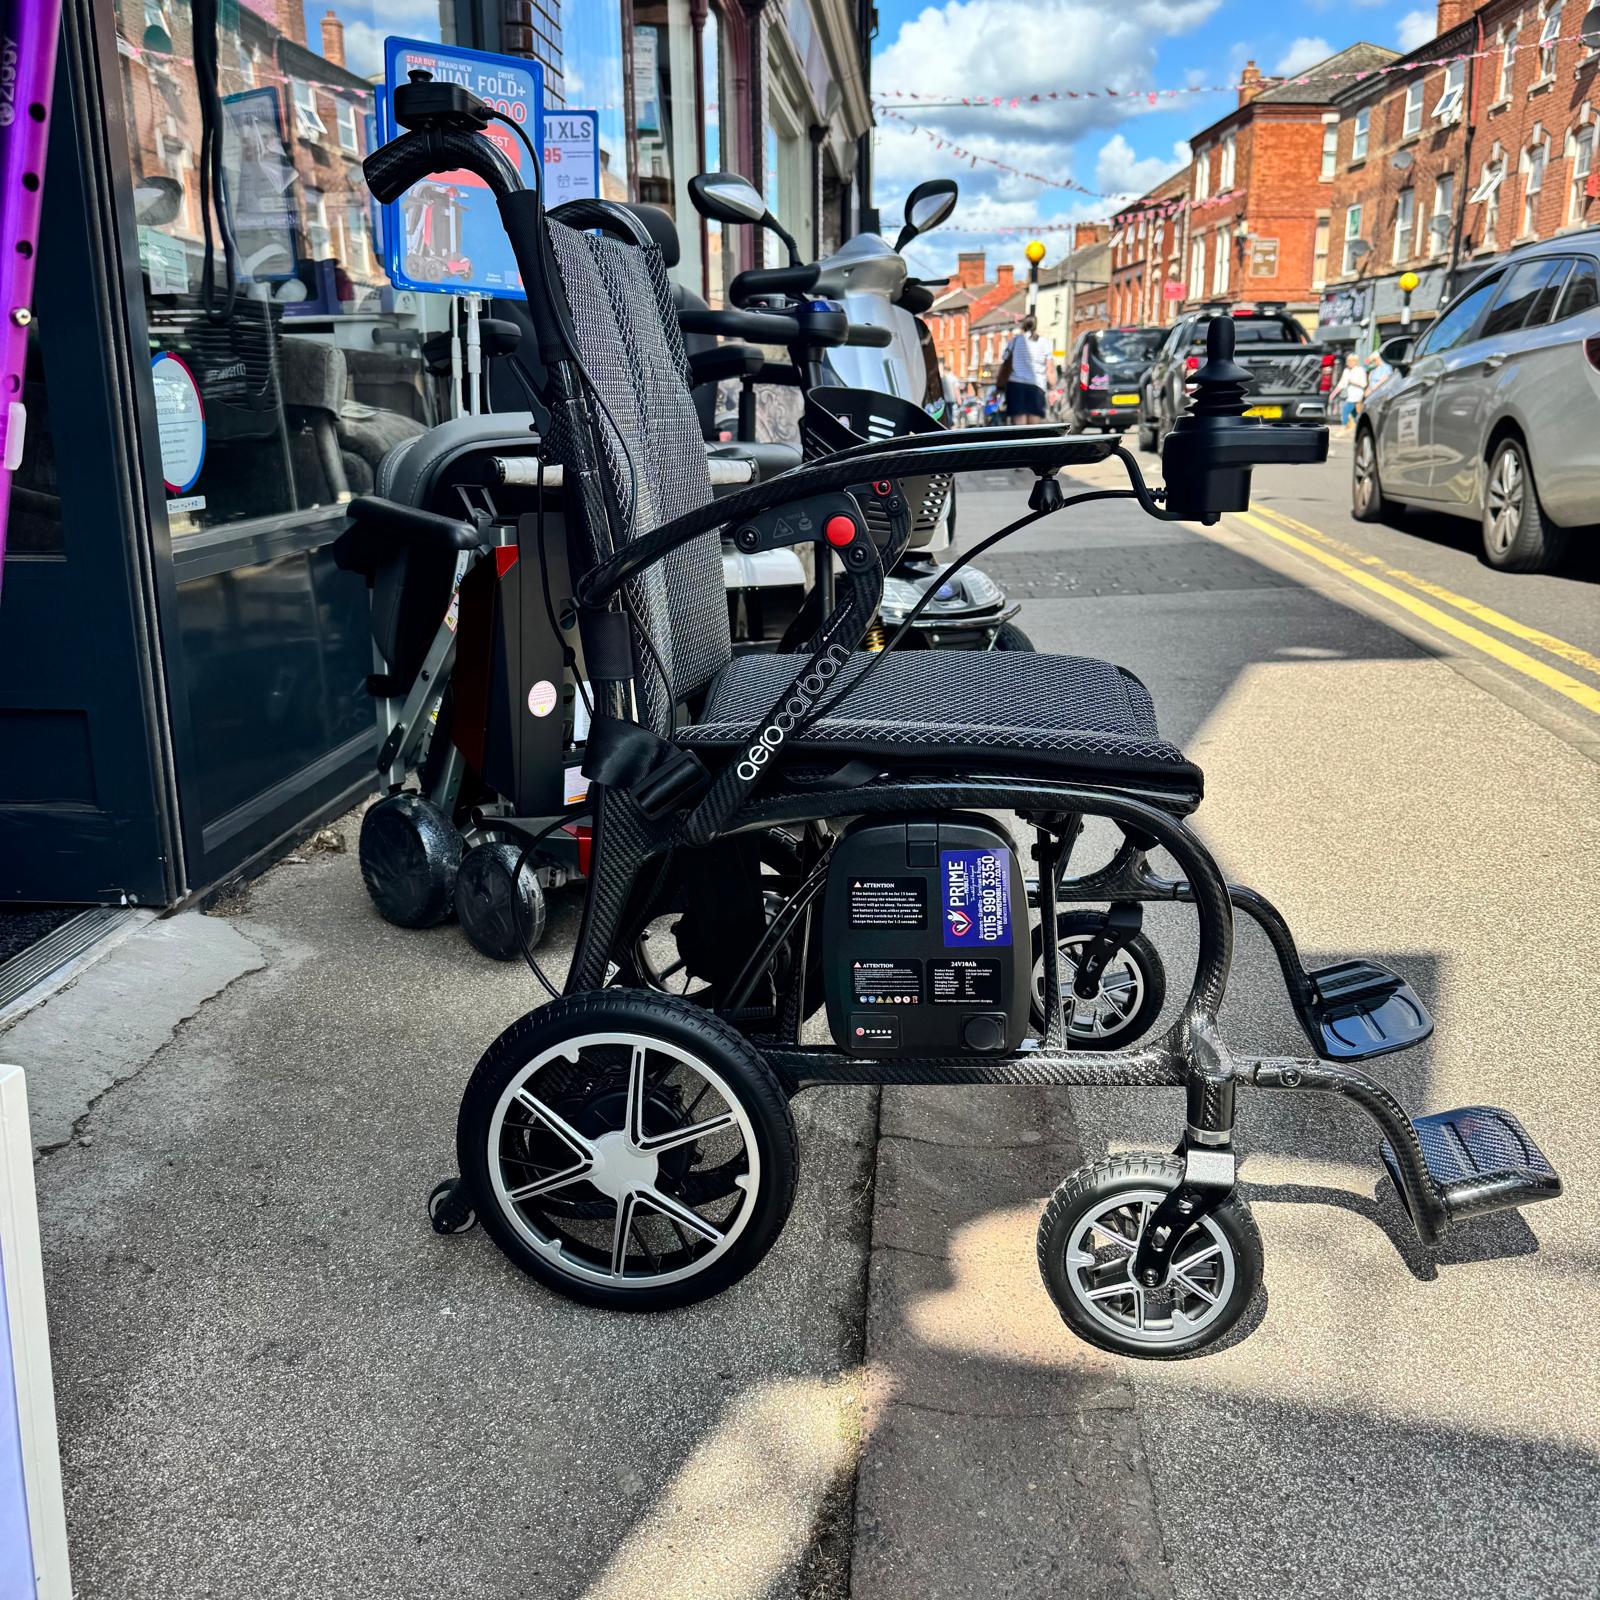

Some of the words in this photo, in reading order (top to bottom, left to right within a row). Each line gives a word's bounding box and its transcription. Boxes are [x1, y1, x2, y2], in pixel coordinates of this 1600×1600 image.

[0, 36, 18, 102] ziggy
[406, 56, 423, 64] STAR
[424, 58, 436, 67] BUY
[406, 64, 474, 90] NUAL
[478, 76, 526, 97] FOLD+
[498, 72, 515, 80] DRIVE
[558, 121, 591, 138] XLS
[736, 644, 850, 780] aerocarbon
[948, 860, 965, 906] PRIME
[982, 856, 995, 886] 3350
[983, 890, 996, 912] 990
[984, 915, 997, 940] 0115
